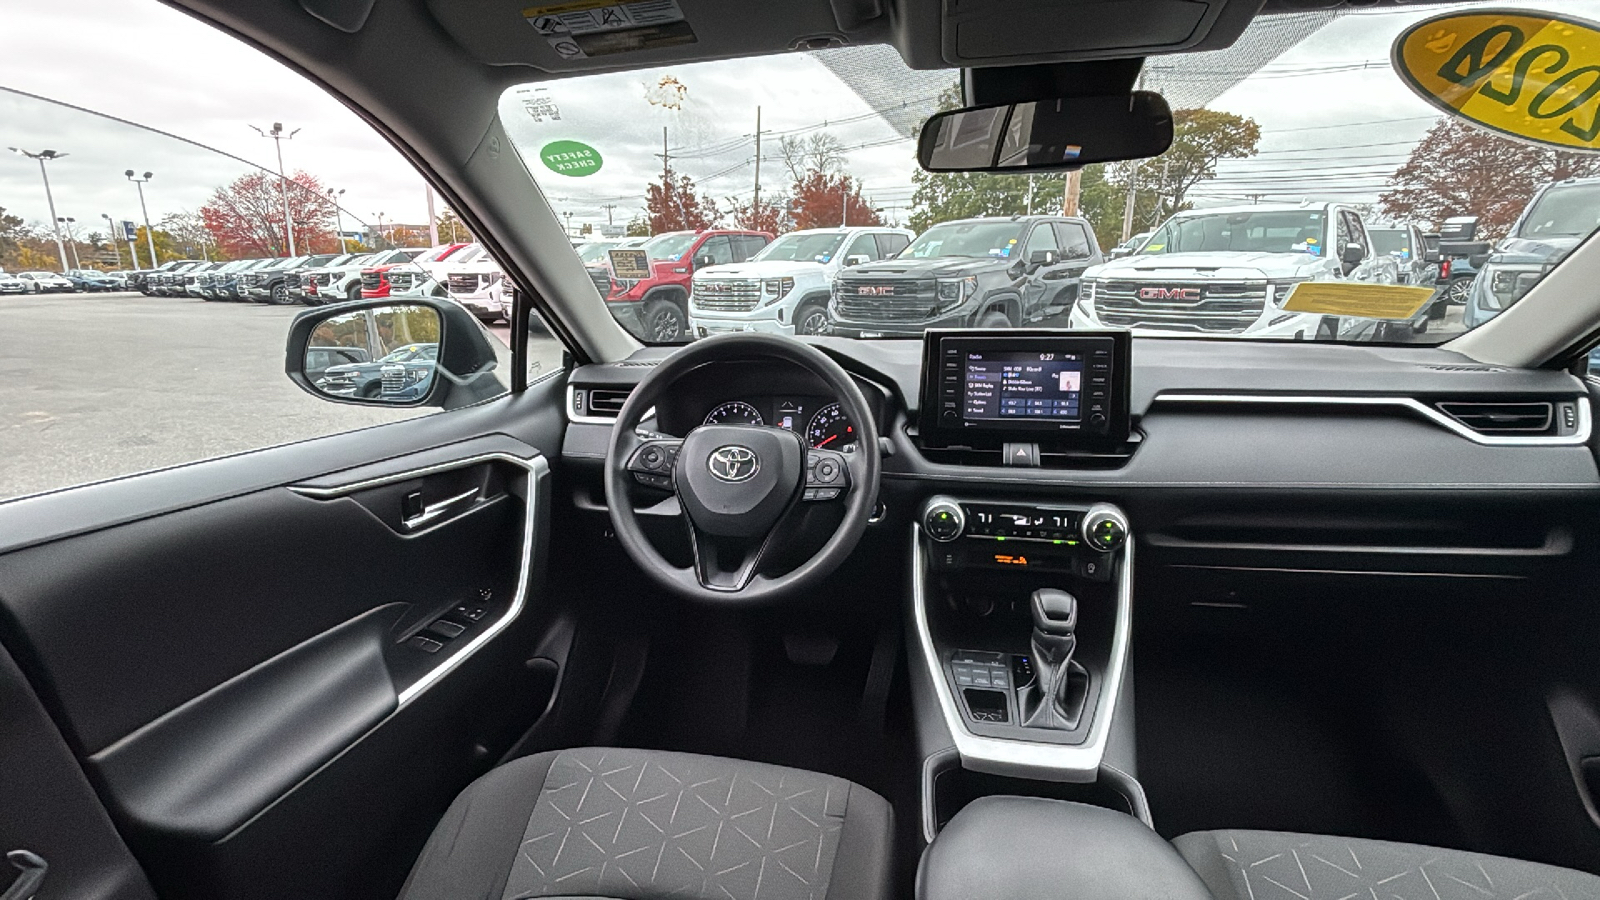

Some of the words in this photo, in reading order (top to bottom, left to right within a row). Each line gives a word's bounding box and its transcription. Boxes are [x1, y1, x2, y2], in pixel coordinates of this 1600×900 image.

[858, 286, 894, 296] GMC
[1140, 287, 1201, 301] GMC
[1040, 353, 1055, 361] 9:27
[978, 512, 993, 524] 71
[1052, 516, 1068, 528] 71
